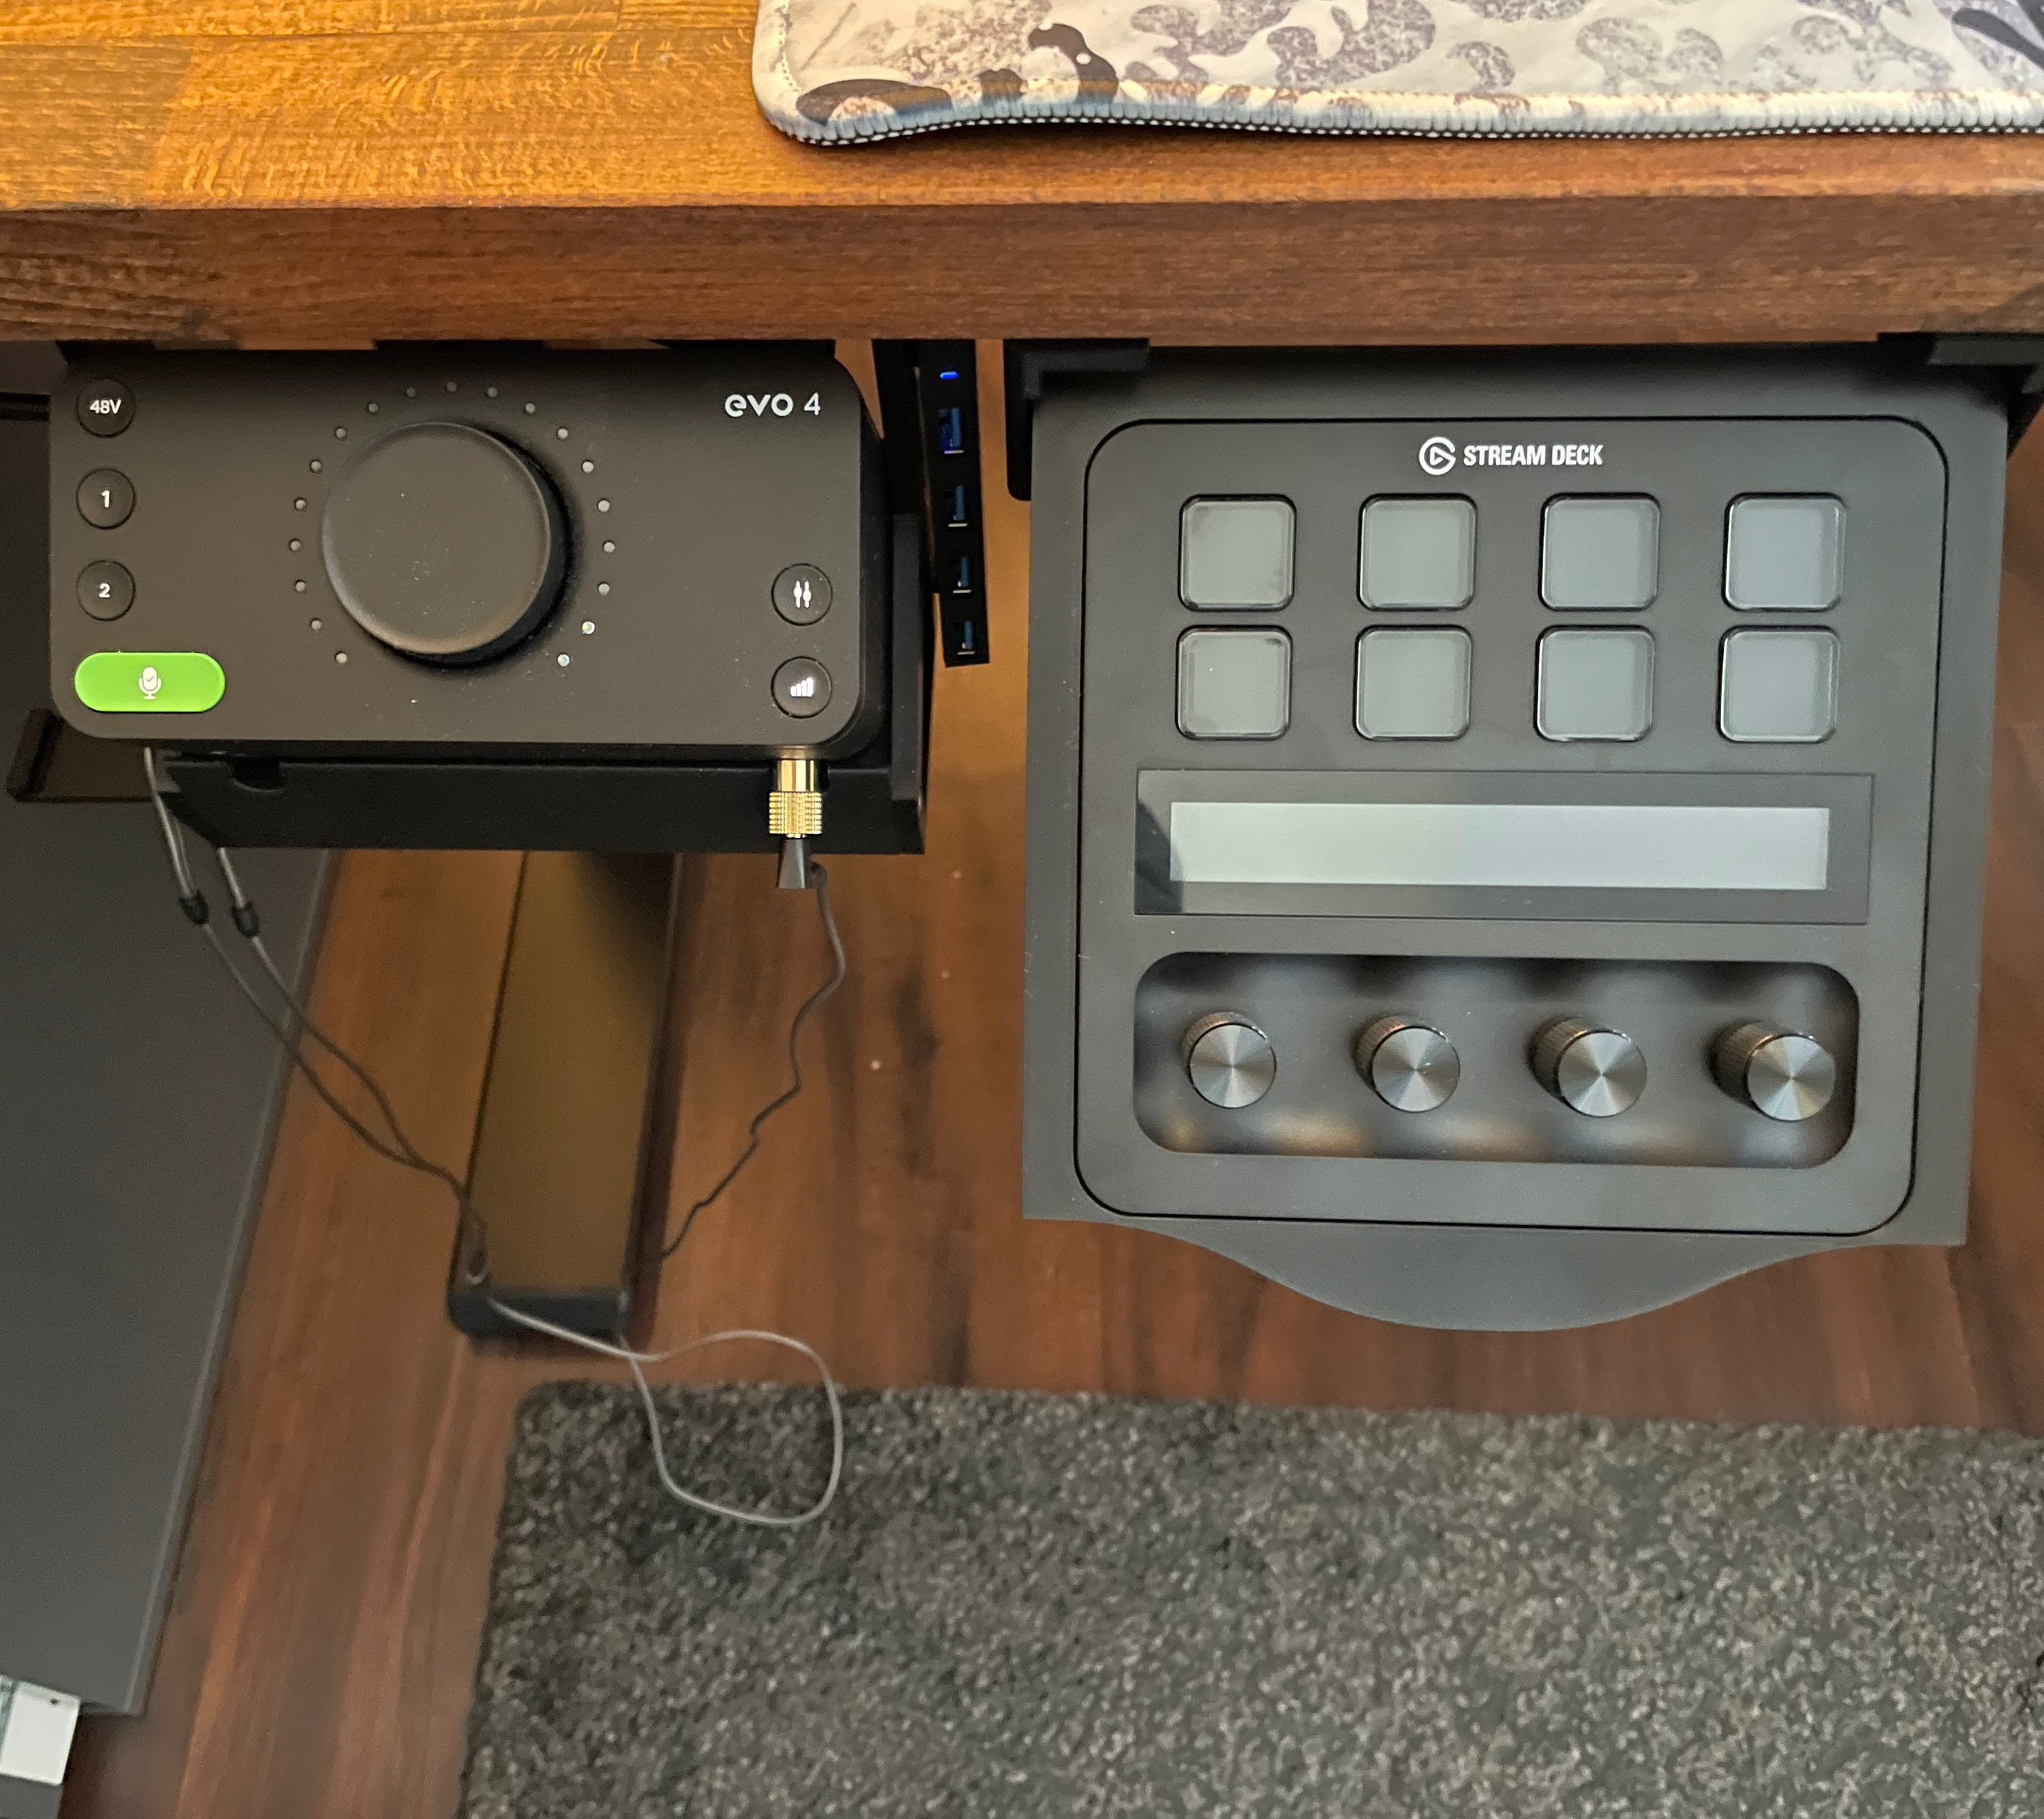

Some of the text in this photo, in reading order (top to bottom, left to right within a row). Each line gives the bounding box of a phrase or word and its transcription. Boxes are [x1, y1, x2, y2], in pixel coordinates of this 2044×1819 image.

[89, 399, 122, 414] 48V
[724, 392, 821, 418] evo 4
[1464, 444, 1603, 466] STREAM DECK
[101, 490, 111, 508] 1
[98, 582, 110, 599] 2
